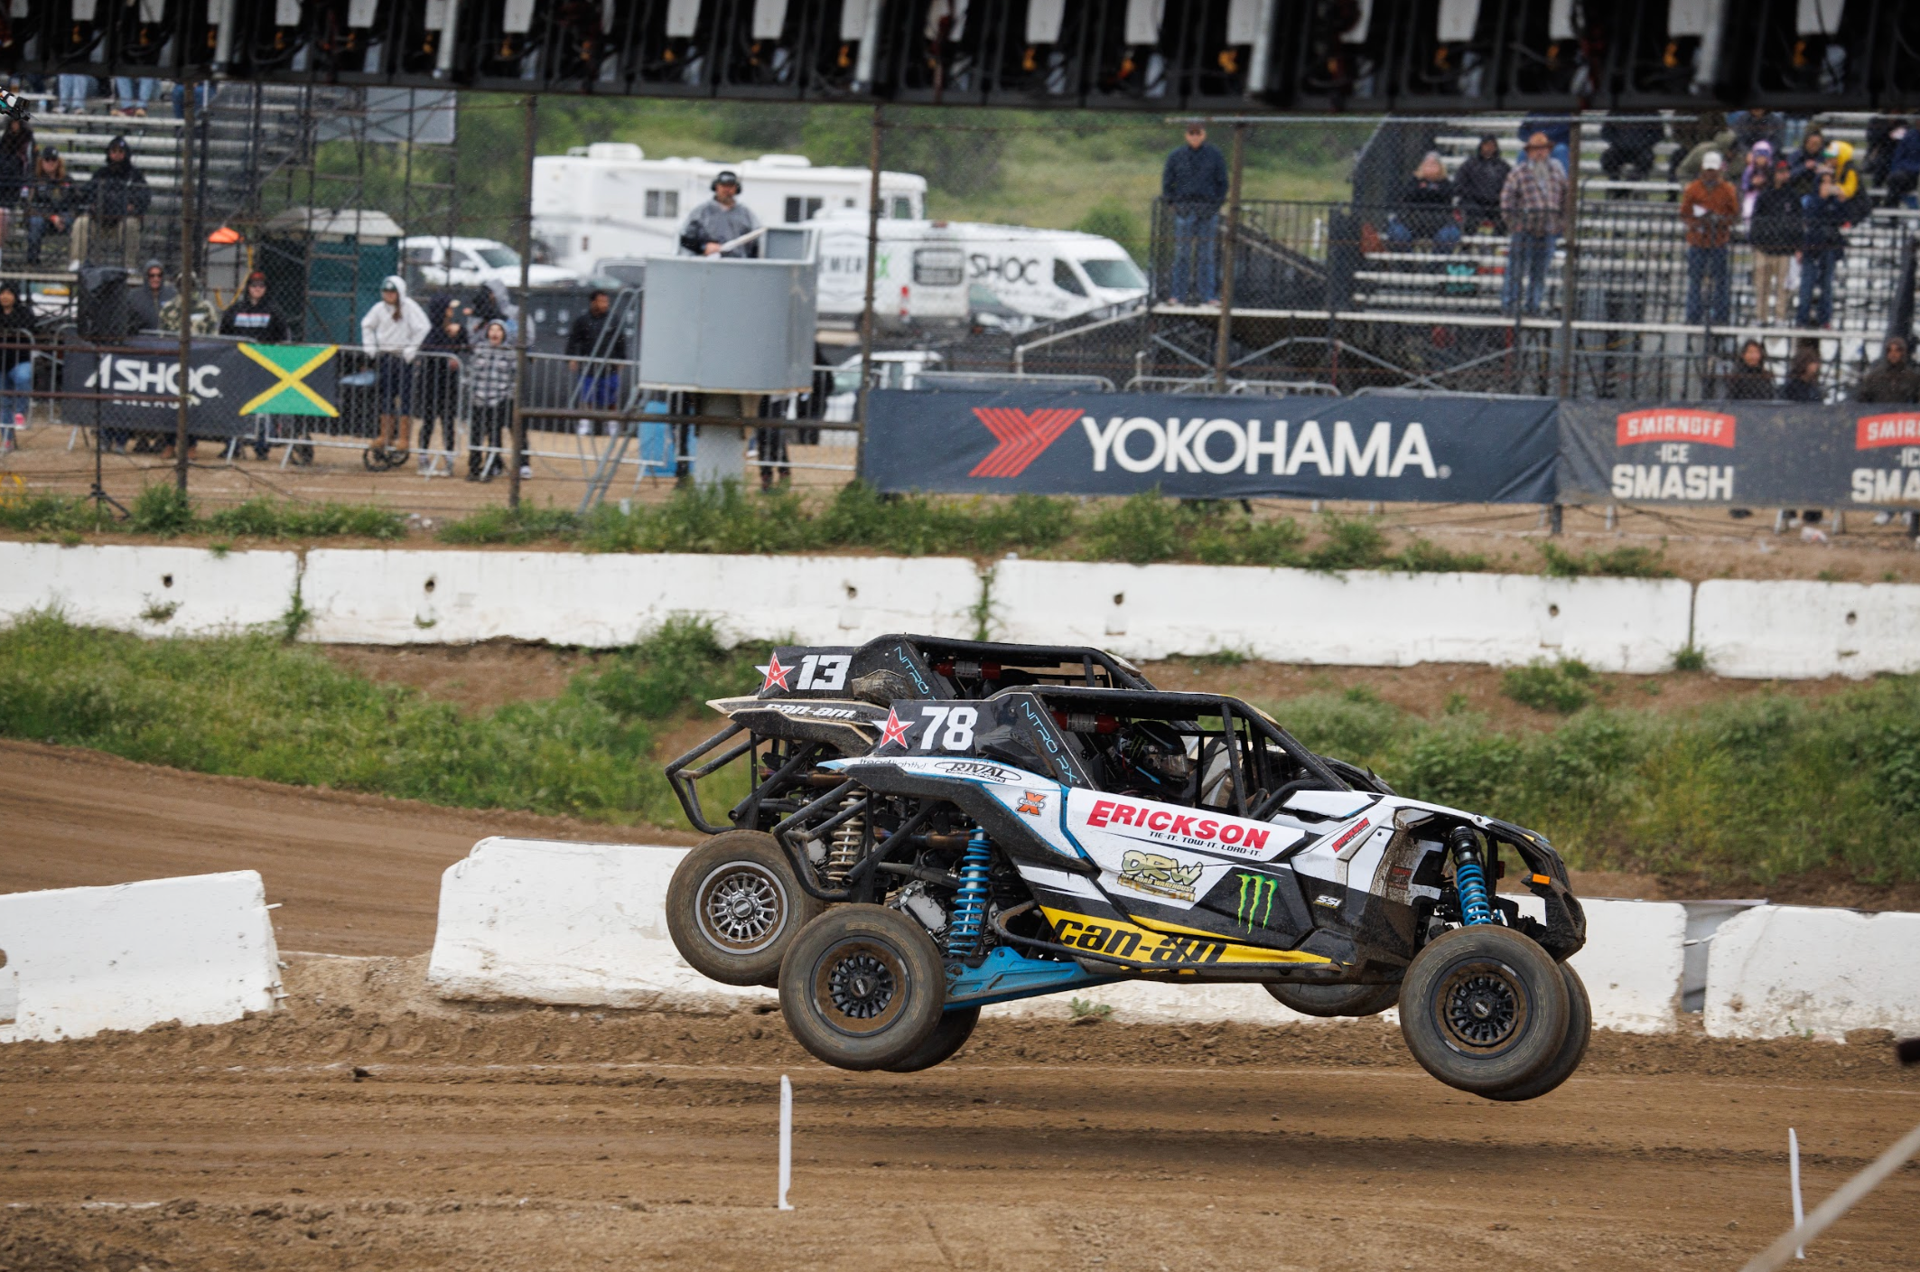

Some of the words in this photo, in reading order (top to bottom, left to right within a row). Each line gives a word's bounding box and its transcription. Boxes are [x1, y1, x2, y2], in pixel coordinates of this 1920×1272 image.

[1081, 416, 1437, 478] YOKOHAMA
[1627, 414, 1725, 439] SMIRNOFF
[1611, 463, 1734, 499] SMASH
[796, 654, 853, 691] 13
[894, 646, 930, 695] NITRO
[920, 706, 979, 751] 78
[1020, 701, 1058, 754] NITRO
[1056, 755, 1078, 783] RX
[1086, 799, 1271, 851] ERICKSON
[1054, 918, 1228, 964] can-am
